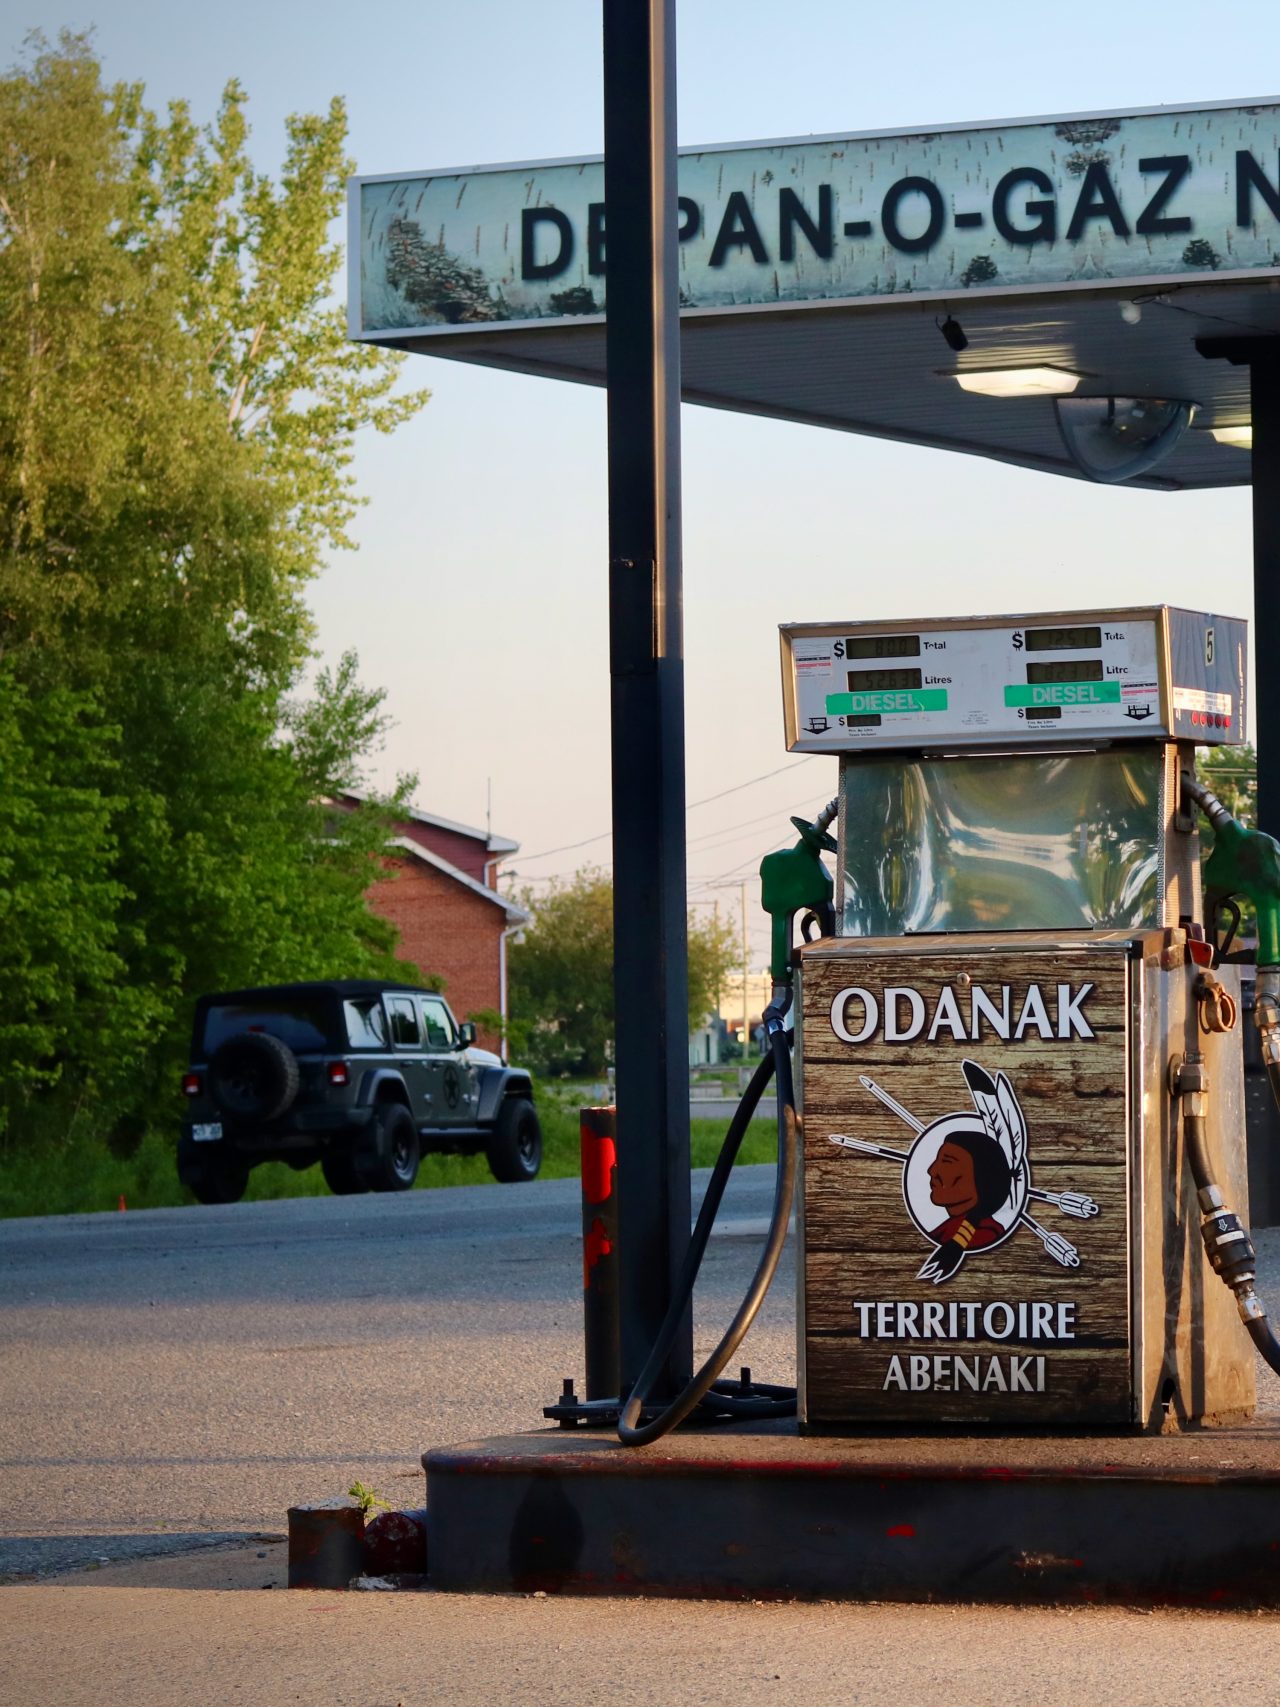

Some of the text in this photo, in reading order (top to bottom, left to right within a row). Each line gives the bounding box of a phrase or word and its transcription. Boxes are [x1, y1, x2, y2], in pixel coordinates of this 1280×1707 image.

[1206, 630, 1214, 663] 5
[925, 675, 953, 685] Litres
[1032, 685, 1101, 704] DIESEL
[852, 693, 919, 711] DIESEL
[829, 982, 1096, 1044] ODANAK
[853, 1301, 1076, 1340] TERRITOIRE
[882, 1354, 1047, 1393] ABENAKI
